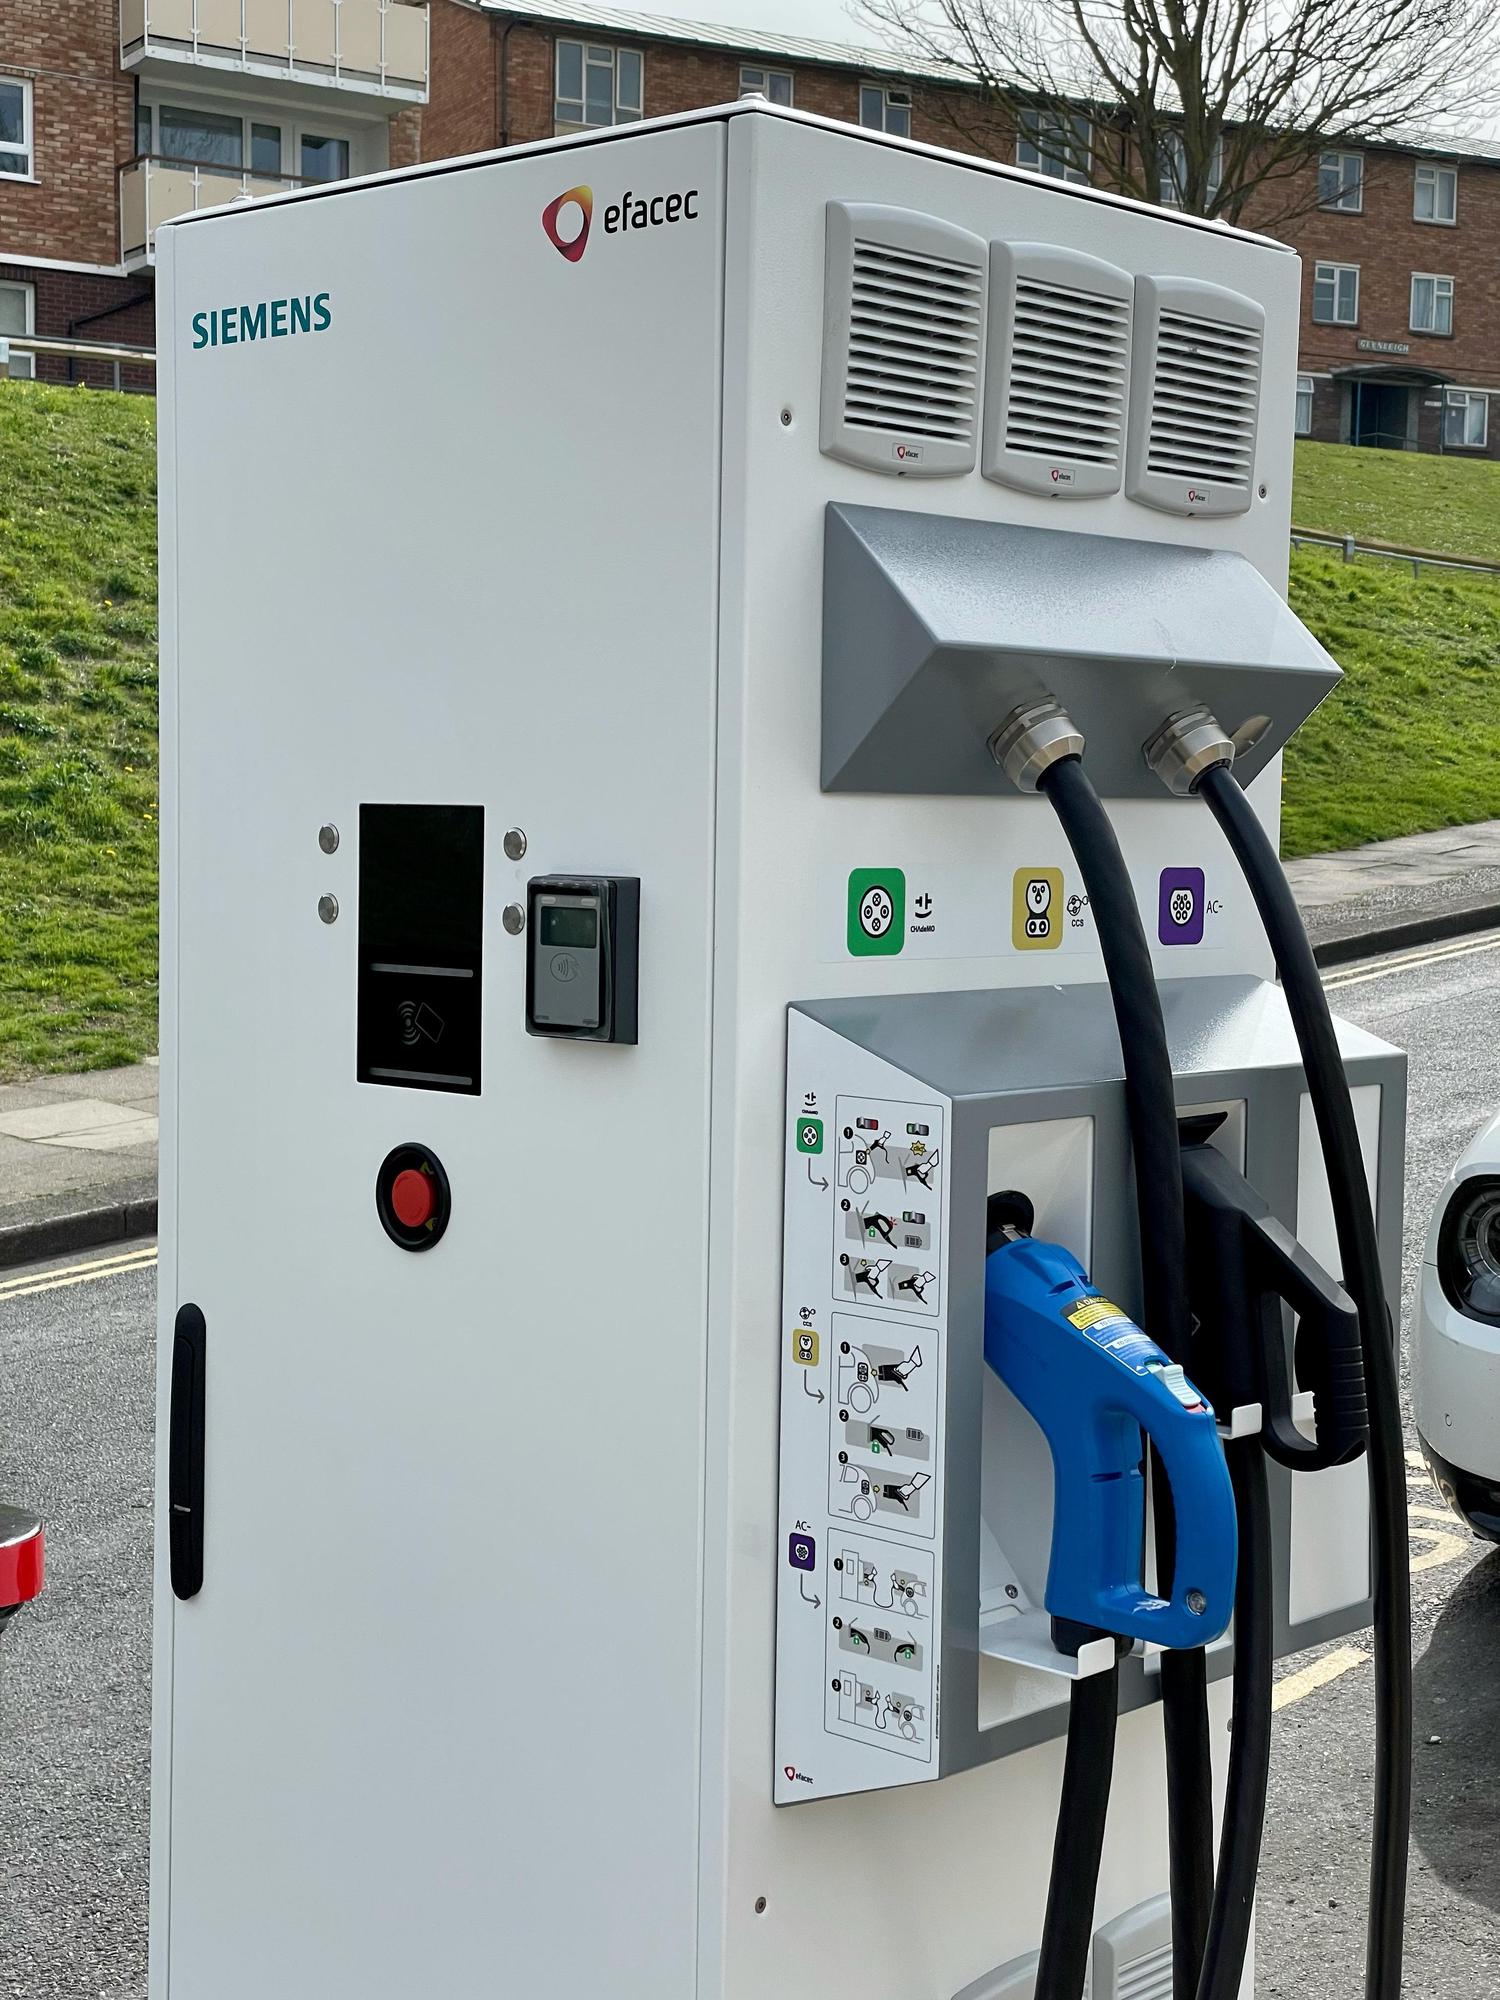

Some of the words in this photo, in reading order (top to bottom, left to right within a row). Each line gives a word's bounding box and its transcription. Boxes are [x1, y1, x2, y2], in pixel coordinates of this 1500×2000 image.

[604, 189, 699, 234] efacec
[192, 292, 332, 350] SIEMENS
[1071, 919, 1084, 928] CCS
